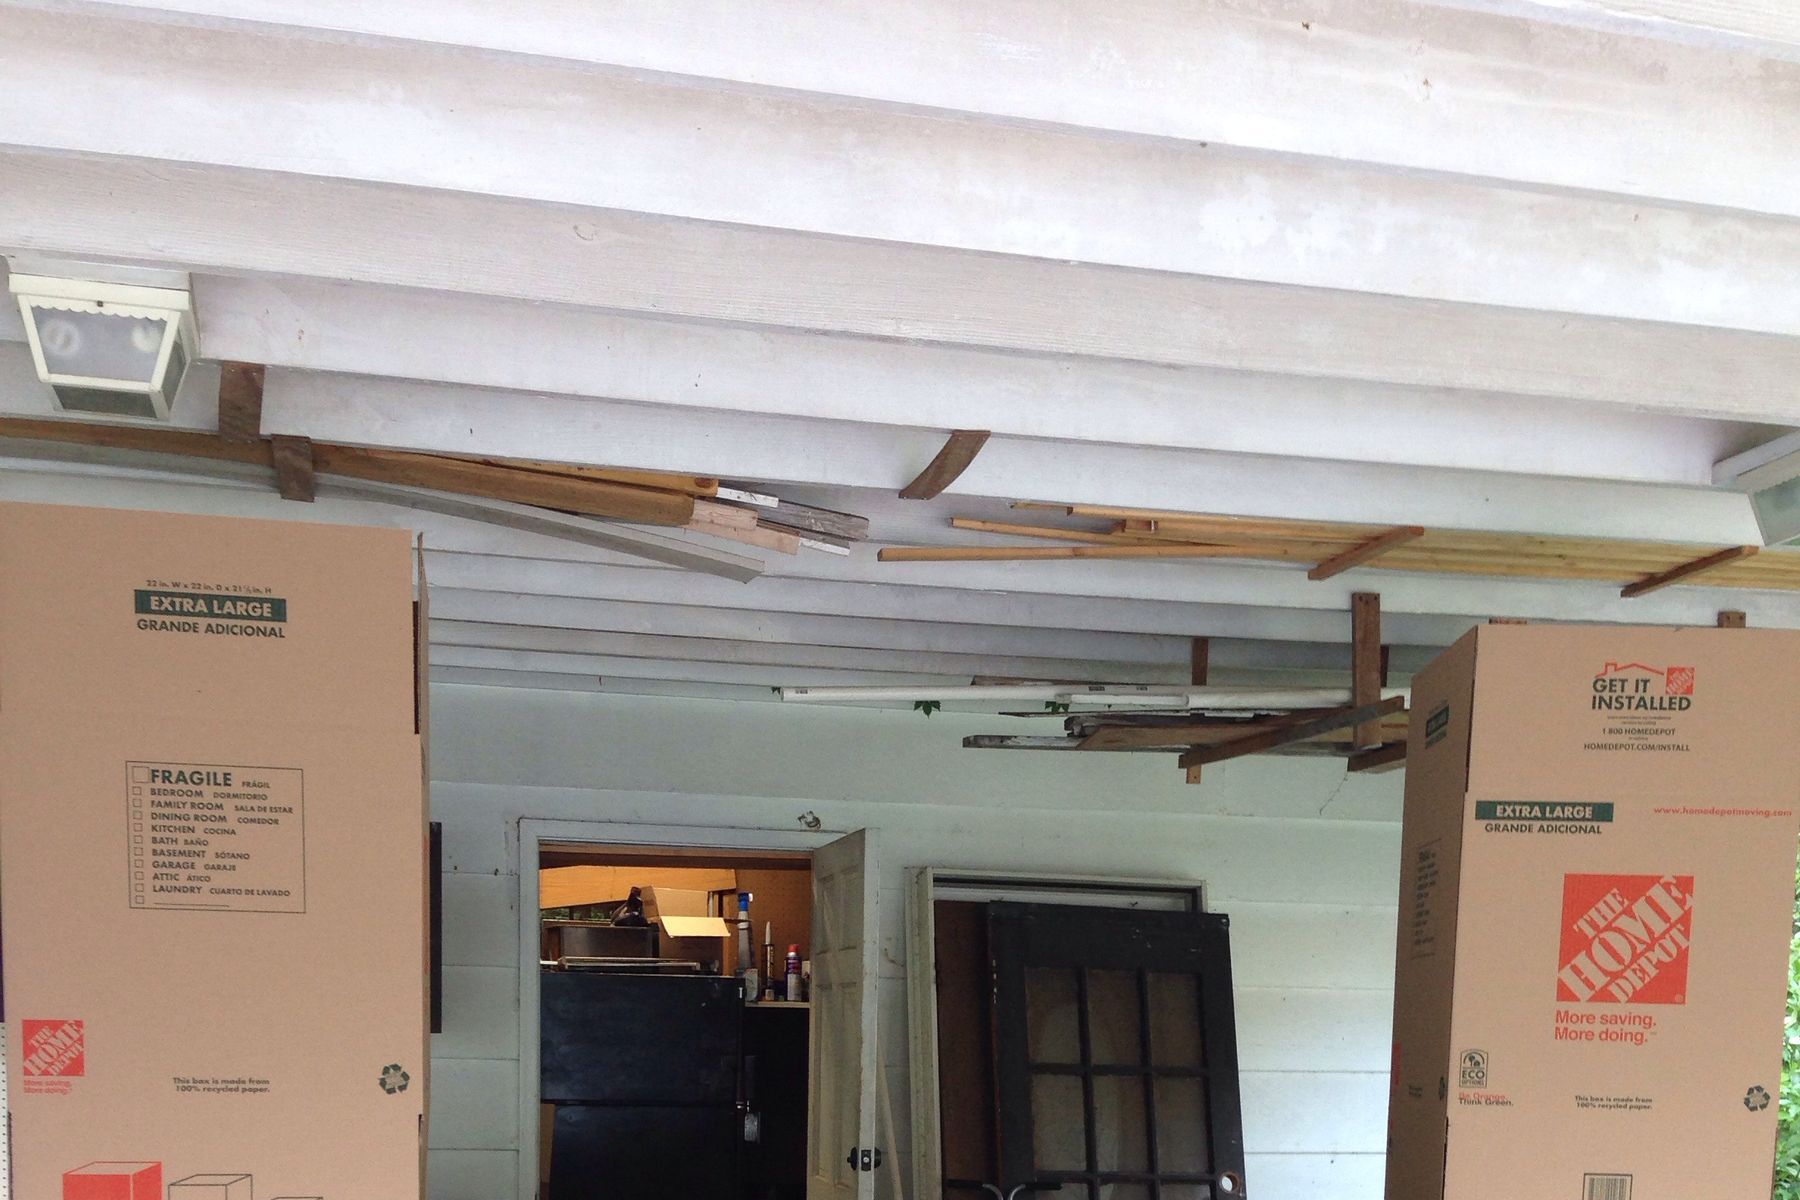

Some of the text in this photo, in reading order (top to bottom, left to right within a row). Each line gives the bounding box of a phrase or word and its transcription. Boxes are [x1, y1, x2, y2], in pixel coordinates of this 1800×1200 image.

[150, 596, 272, 617] EXTRA LARGE
[137, 619, 285, 638] GRANDE ADICIONAL
[1593, 678, 1651, 693] GET IT
[1592, 696, 1691, 711] INSTALLED
[1584, 743, 1690, 752] HOMEDEPOT.COM/INSTALL
[151, 769, 232, 787] FRAGILE
[151, 788, 204, 797] BEDROOM
[151, 800, 224, 811] FAMILY ROOM
[1496, 804, 1593, 819] EXTRA LARGE
[1654, 806, 1793, 817] www.homedepotmoving.com
[151, 813, 227, 823] DINING ROOM
[151, 825, 195, 833] KITCHEN
[1485, 823, 1602, 834] GRANDE ADICIONAL
[152, 837, 178, 845] BATH
[152, 849, 206, 858] BASEMENT
[153, 861, 196, 869] GARAGE
[153, 873, 180, 881] ATTIC
[153, 886, 202, 894] LAUNDRY
[1574, 887, 1629, 939] THE
[1558, 874, 1694, 1001] HOME
[1606, 924, 1690, 1004] DEPOT
[1555, 1010, 1657, 1029] More saving.
[1554, 1027, 1648, 1045] More doing.
[1461, 1071, 1484, 1080] ECO
